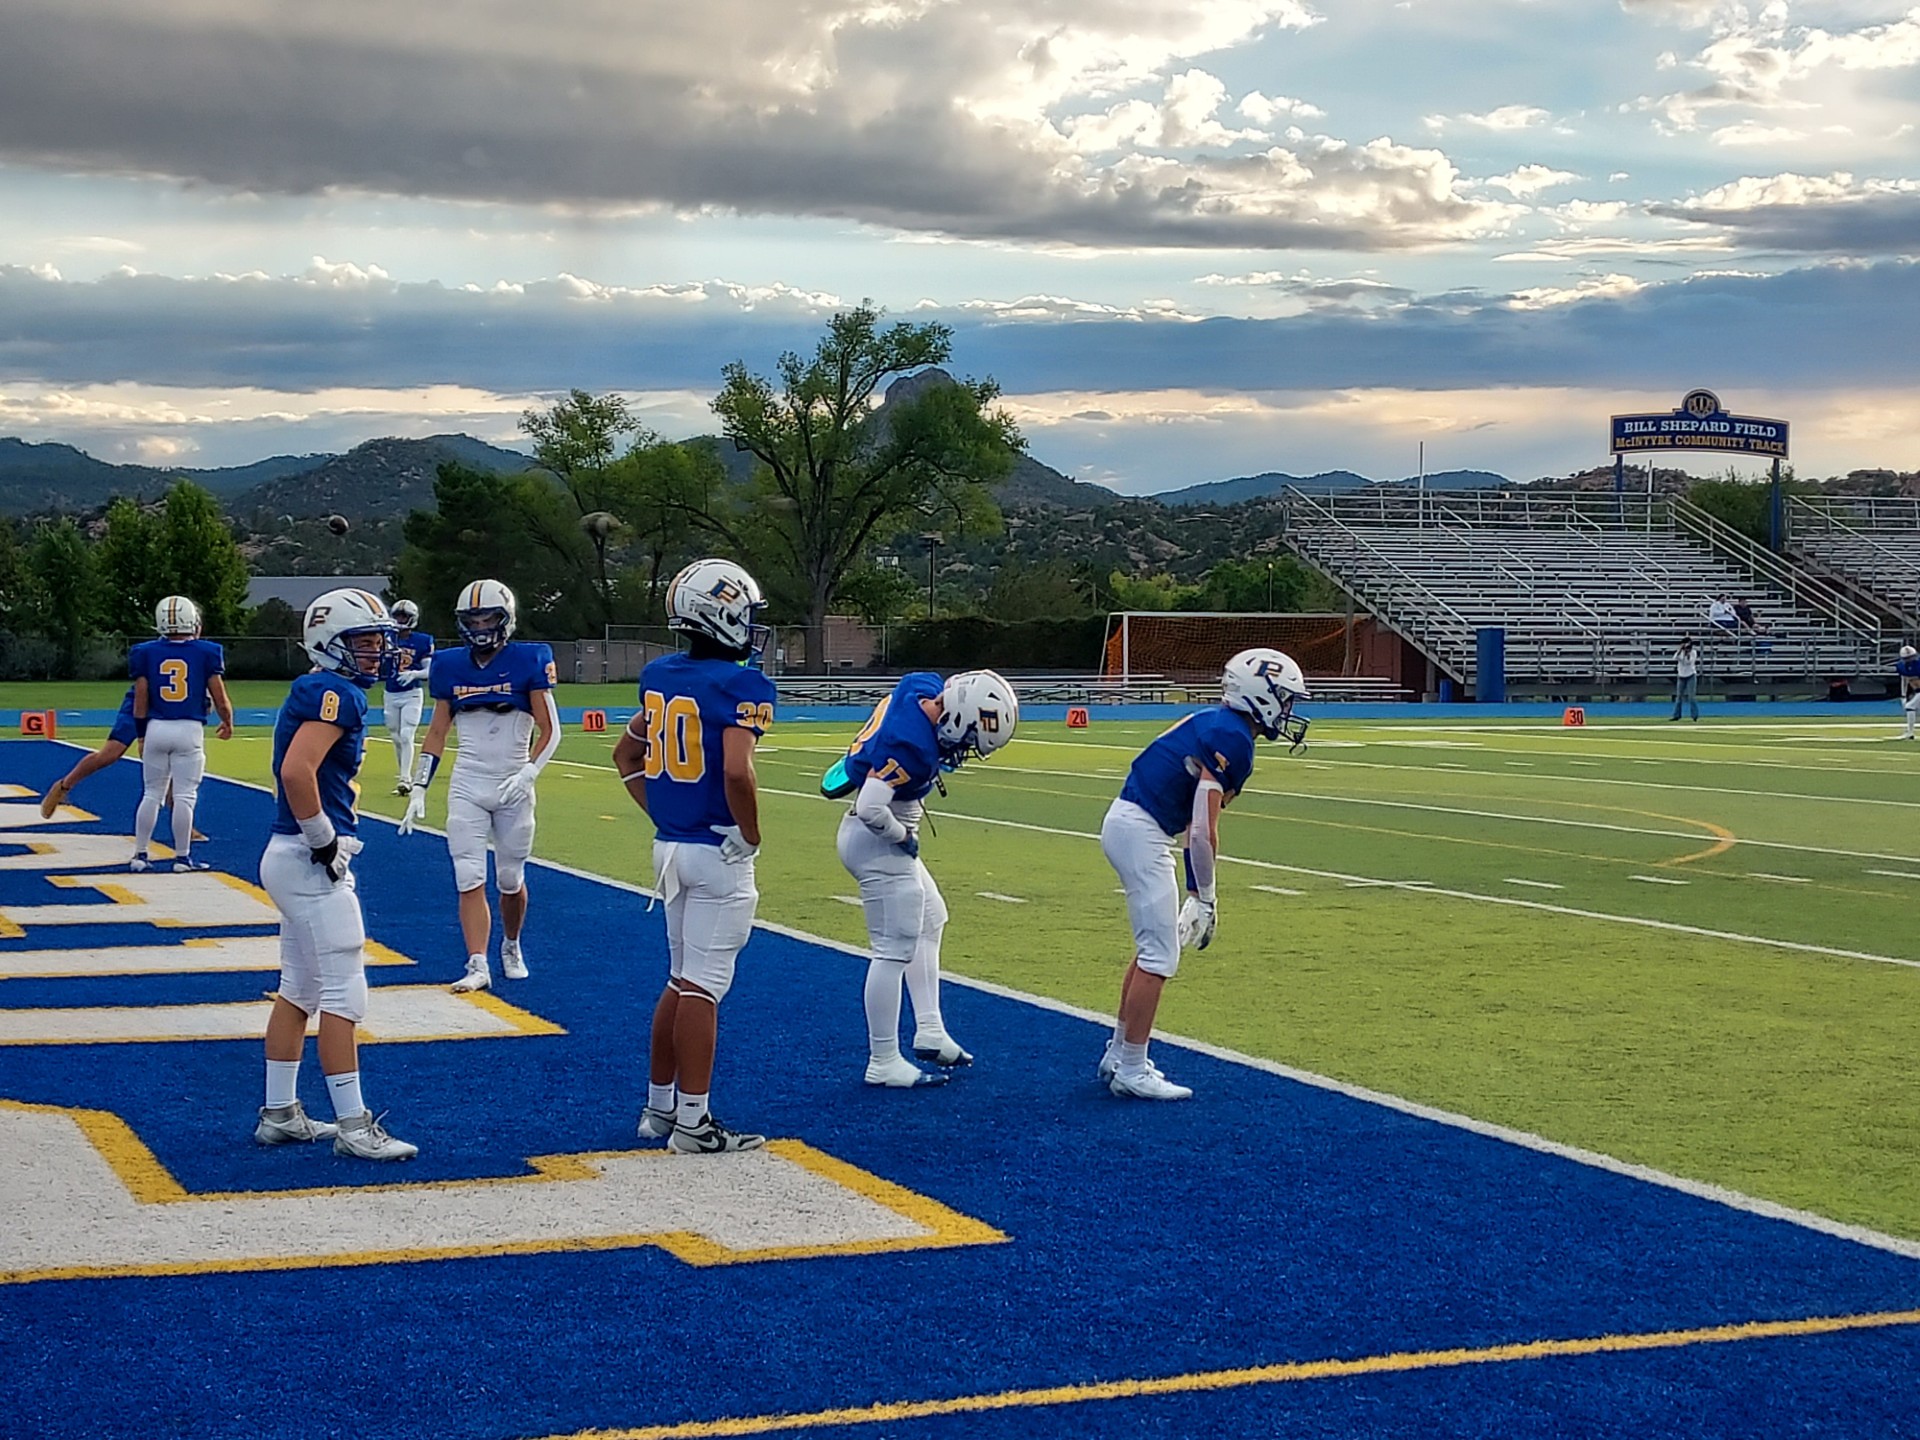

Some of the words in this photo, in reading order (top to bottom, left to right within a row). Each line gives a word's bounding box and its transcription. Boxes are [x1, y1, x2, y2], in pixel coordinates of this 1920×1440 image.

[1624, 421, 1656, 433] BILL
[1660, 420, 1730, 433] SHEPARD
[1734, 422, 1777, 438] FIELD
[1615, 435, 1673, 448] McINTYRE
[1675, 435, 1745, 448] COMMUNITY
[1749, 438, 1785, 453] TRACK
[159, 658, 188, 702] 3
[319, 690, 340, 722] 8
[26, 716, 43, 731] G
[587, 713, 604, 729] 10
[736, 702, 774, 731] 30
[1071, 710, 1087, 725] 20
[1569, 709, 1584, 725] 30
[644, 690, 706, 783] 30
[876, 758, 912, 789] 17
